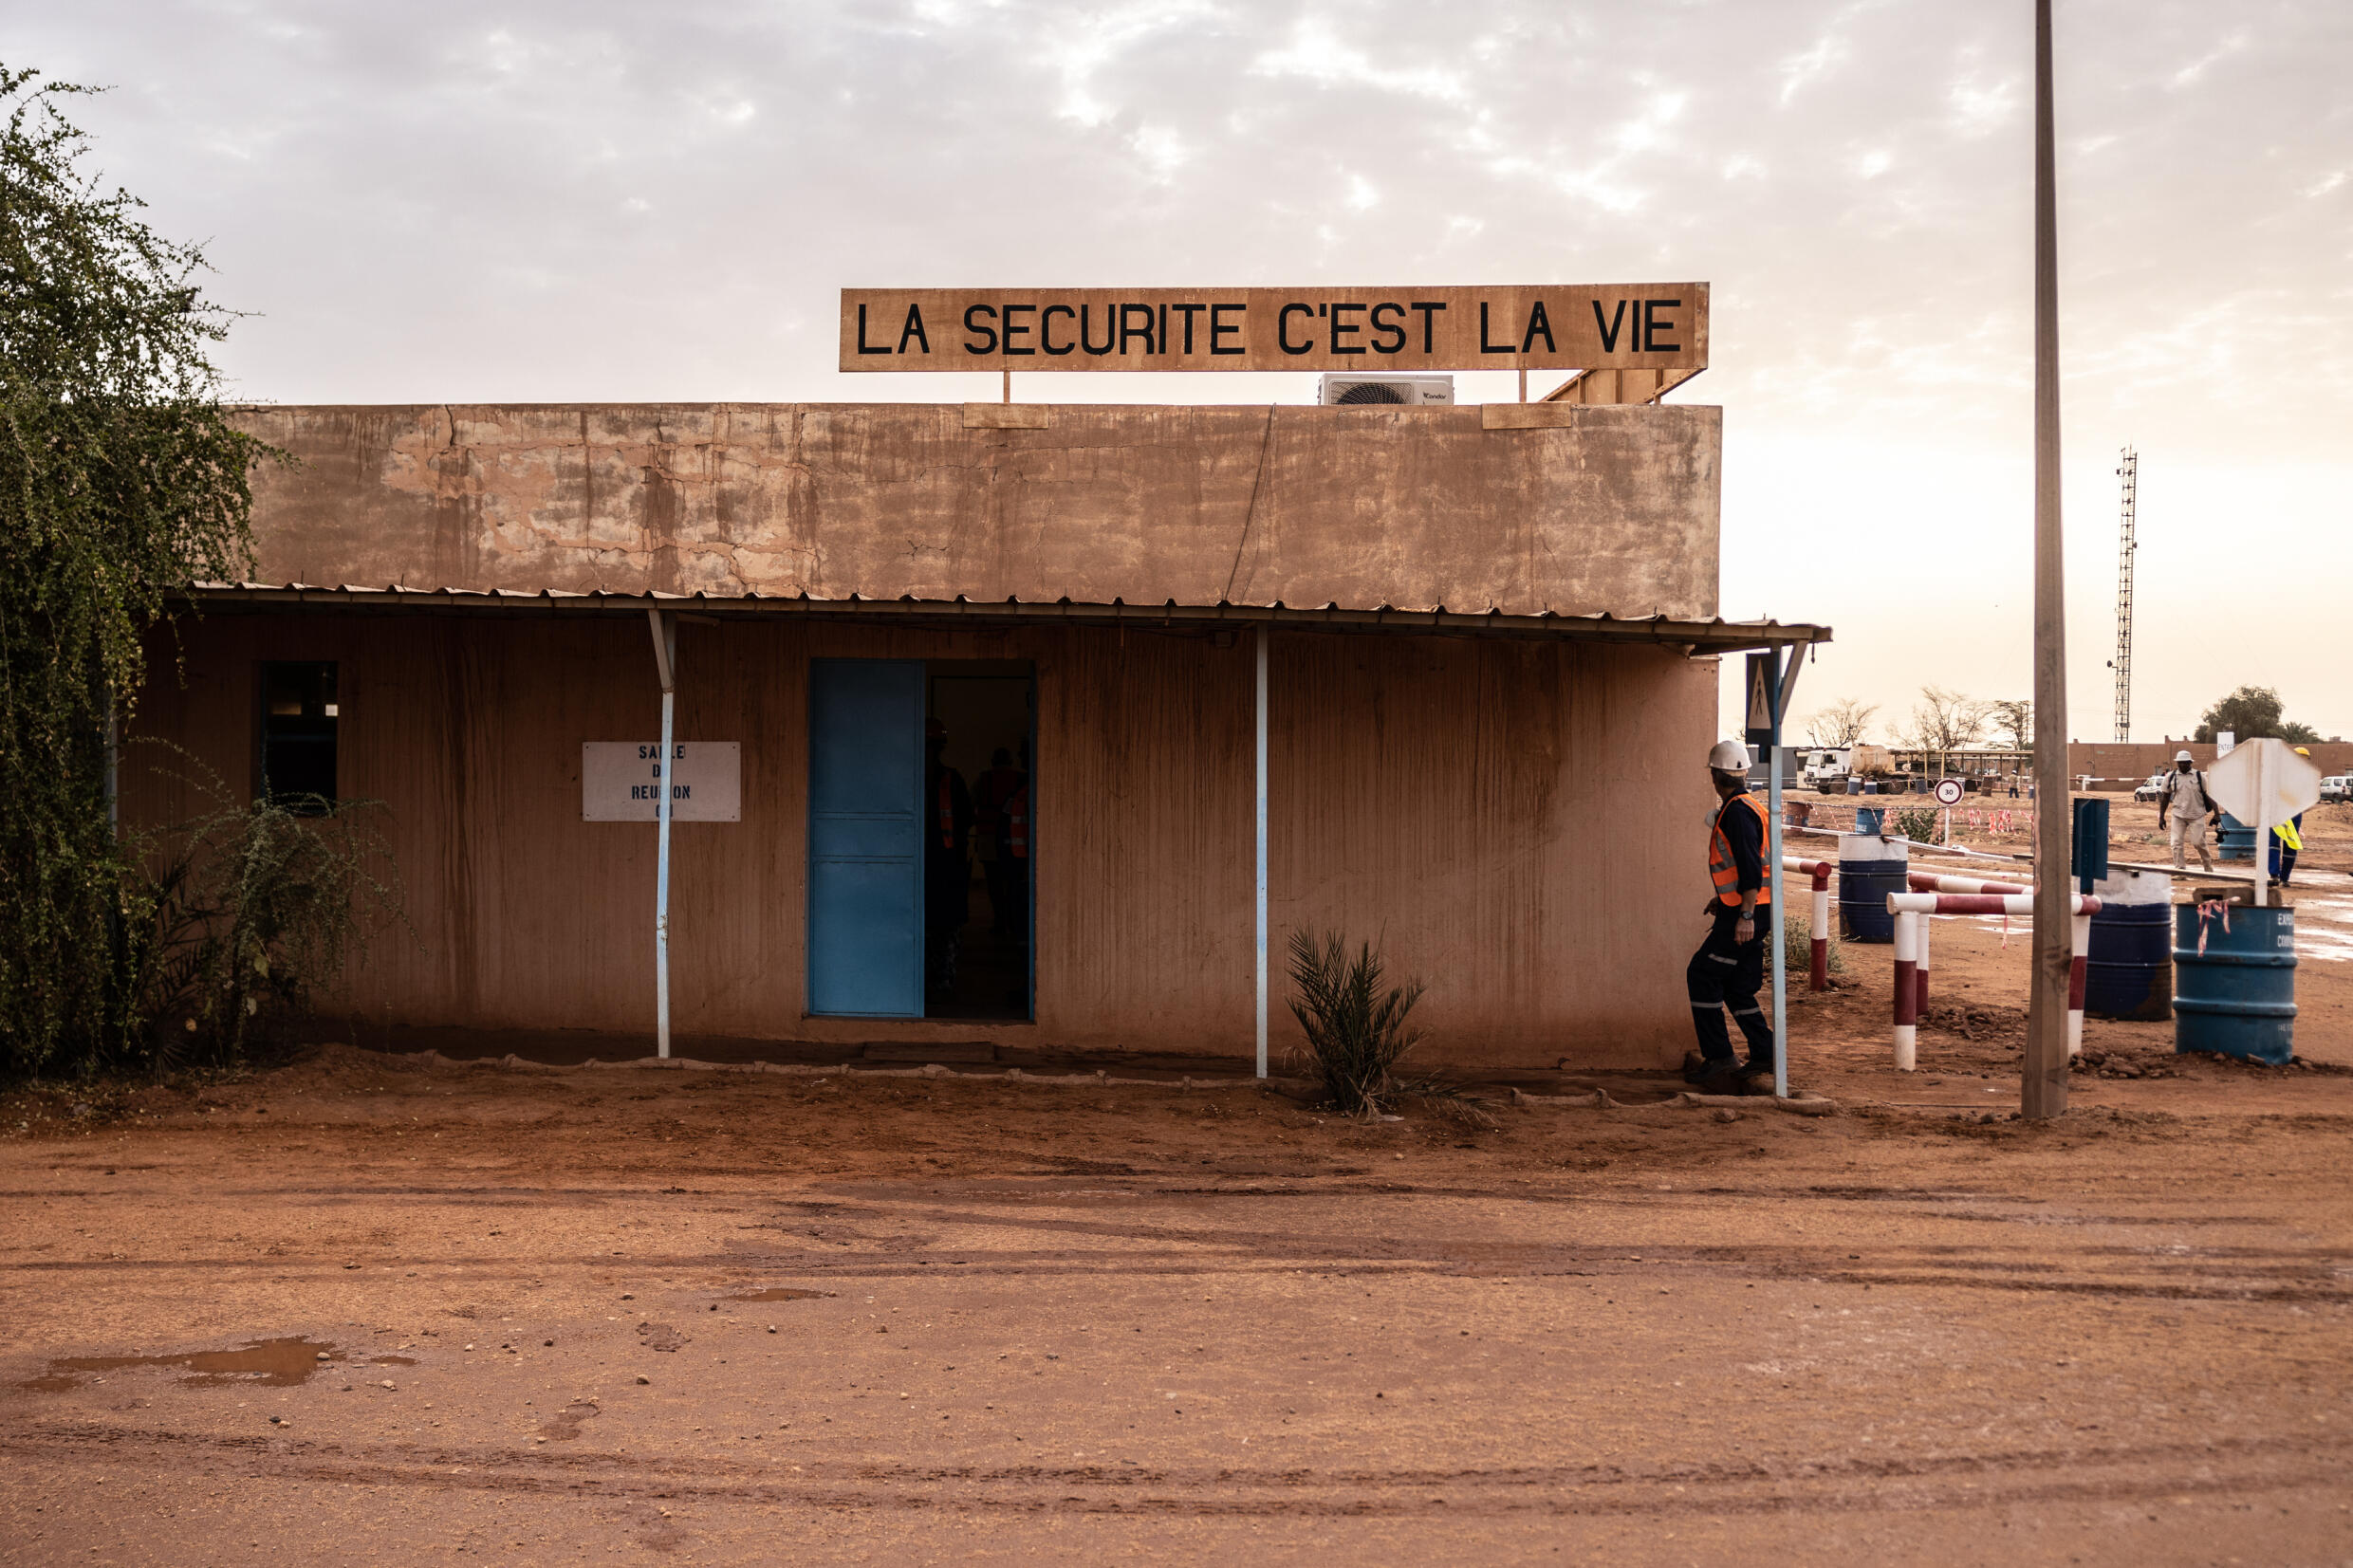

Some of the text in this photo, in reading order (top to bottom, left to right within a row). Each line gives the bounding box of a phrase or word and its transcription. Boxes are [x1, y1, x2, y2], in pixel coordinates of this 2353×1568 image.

[858, 299, 1681, 356] LA SECURITE C'EST LA VIE
[639, 745, 685, 759] SAE
[631, 785, 691, 800] REUON
